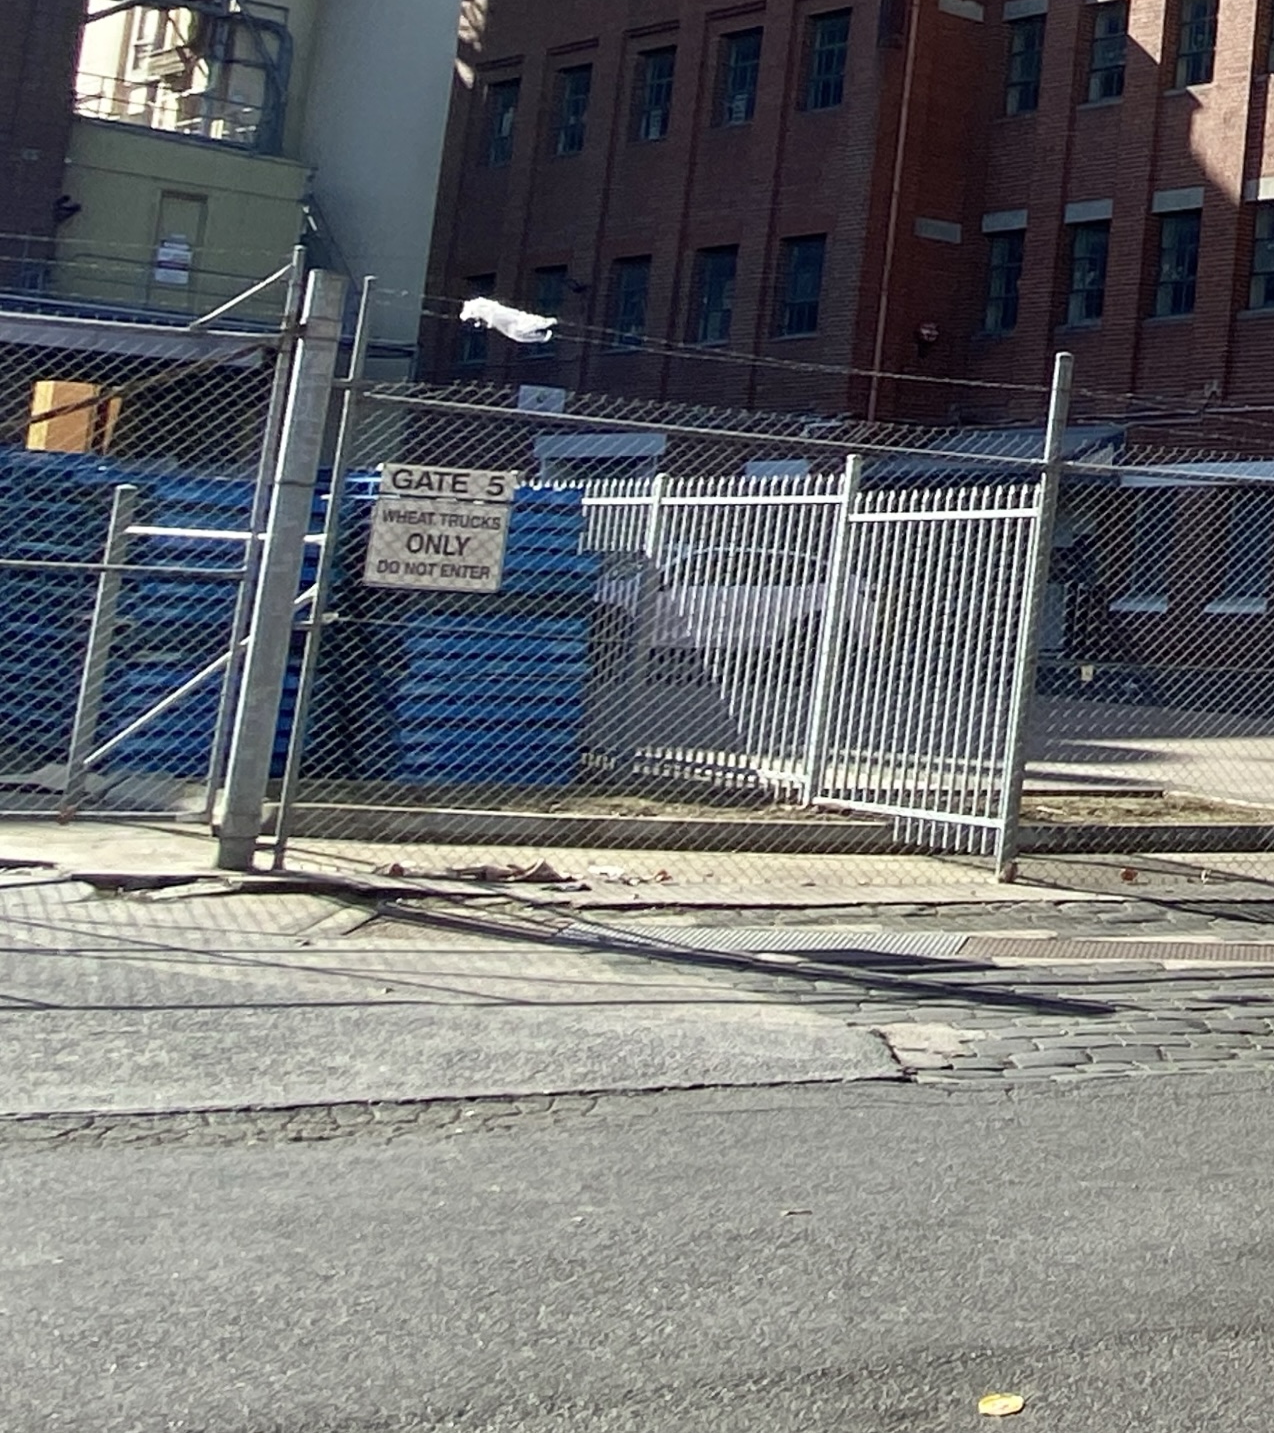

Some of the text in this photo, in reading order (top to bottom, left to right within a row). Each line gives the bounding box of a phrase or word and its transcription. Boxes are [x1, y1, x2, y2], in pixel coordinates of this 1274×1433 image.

[392, 468, 506, 496] GATE 5
[382, 509, 501, 530] WHEAT TRUCKS
[406, 532, 471, 556] ONLY
[376, 559, 491, 579] DO NOT ENTER
